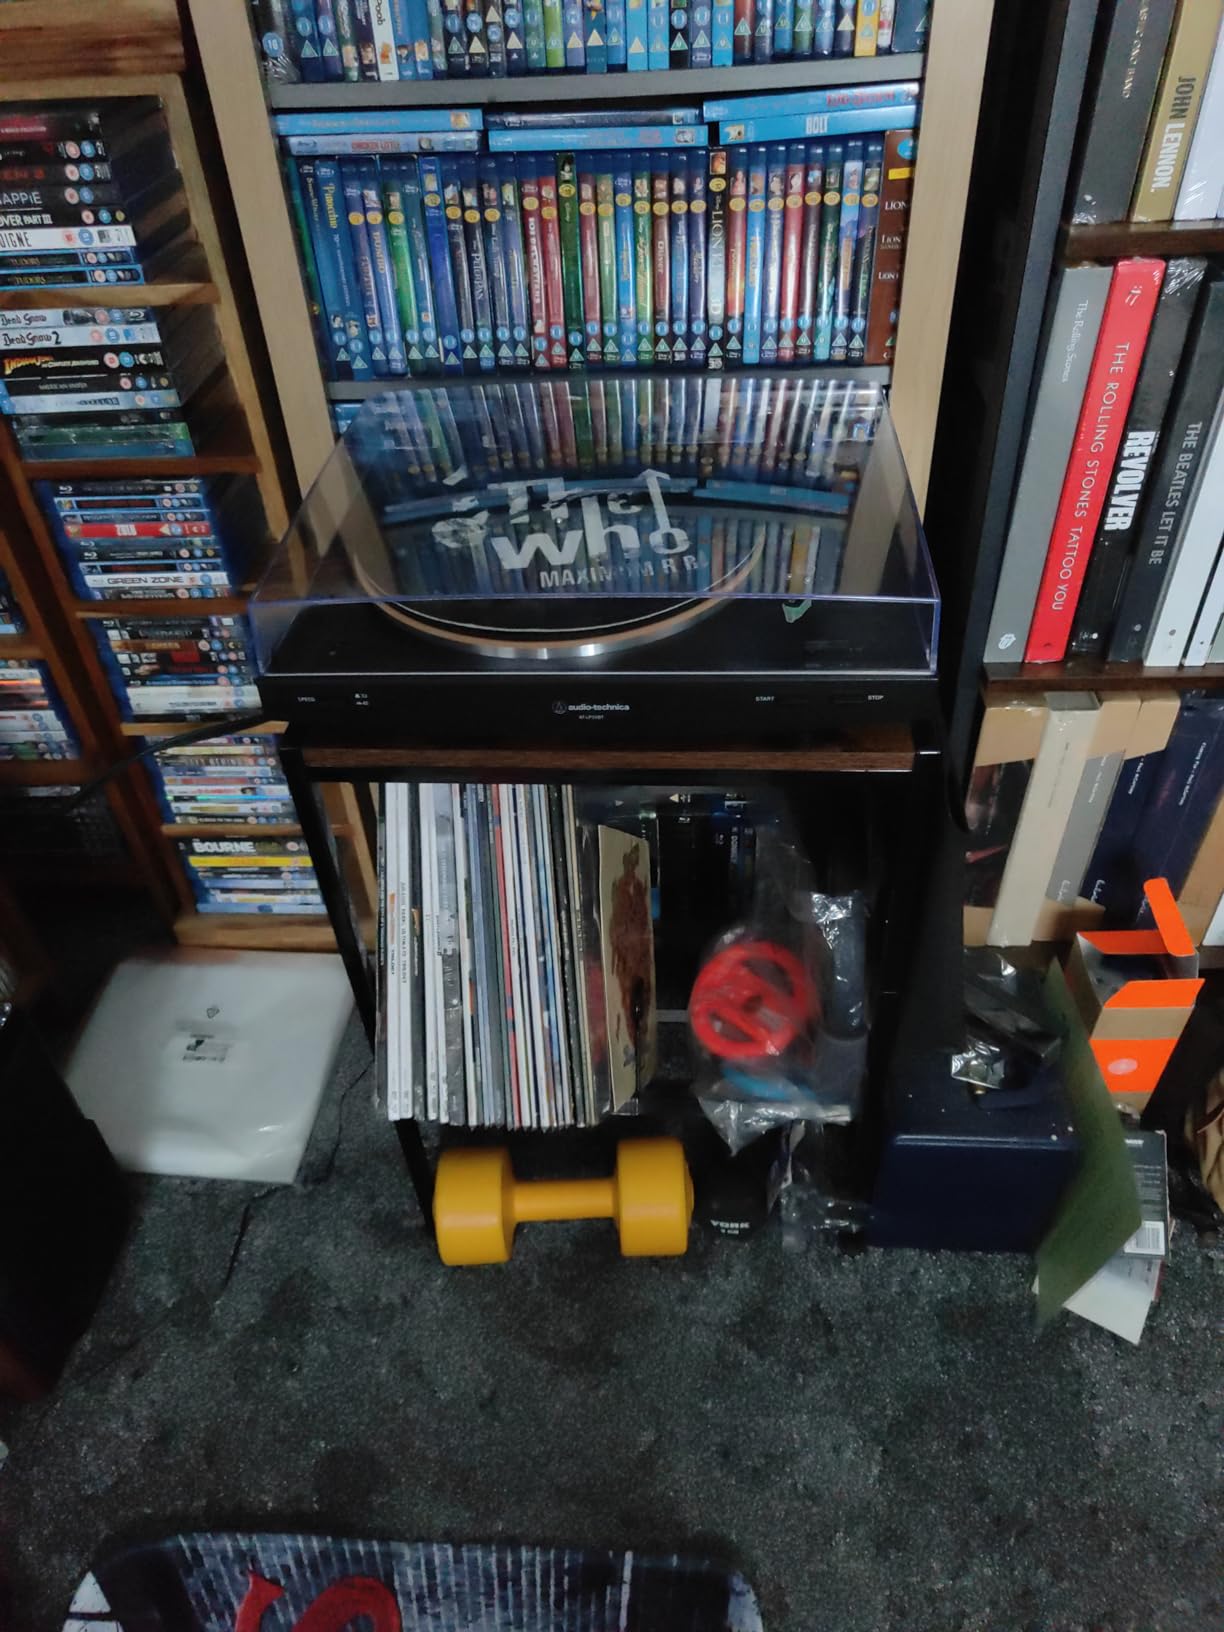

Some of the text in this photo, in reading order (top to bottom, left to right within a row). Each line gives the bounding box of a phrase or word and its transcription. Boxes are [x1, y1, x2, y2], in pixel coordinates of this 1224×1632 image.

[1169, 76, 1196, 120] JOHN
[806, 115, 829, 135] BOLT
[711, 209, 724, 250] LION
[51, 331, 62, 345] 2
[1052, 342, 1129, 611] THE ROLLING STONES TATTOO YOU
[1103, 430, 1157, 531] REVOLVER
[1148, 421, 1203, 565] THE BEATLES LET IT BE
[107, 574, 185, 585] GREEN ZONE
[567, 702, 630, 712] audio-technica
[193, 840, 257, 854] BOURNE
